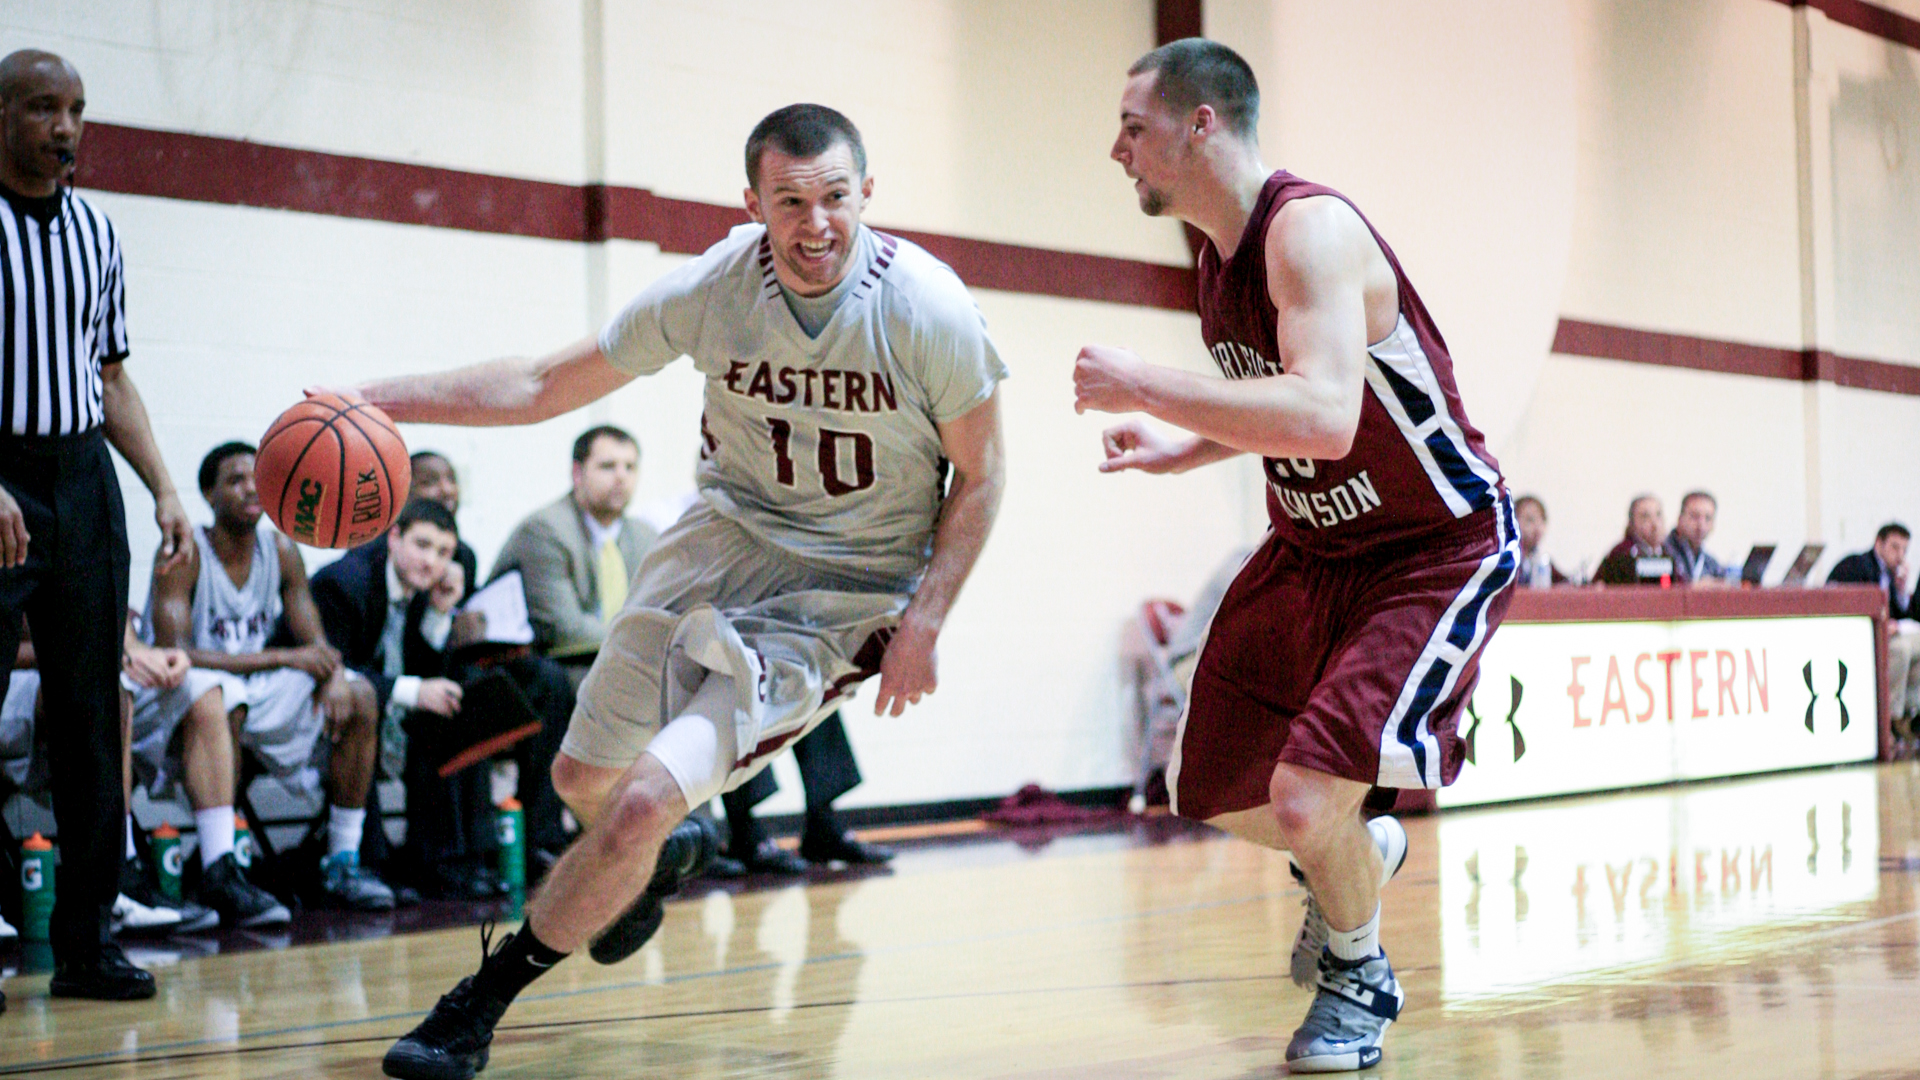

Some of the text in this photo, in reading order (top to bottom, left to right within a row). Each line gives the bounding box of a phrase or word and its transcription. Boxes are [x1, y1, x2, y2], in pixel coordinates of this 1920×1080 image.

[723, 360, 898, 412] EASTERN
[765, 416, 875, 497] 10
[352, 467, 382, 525] ROCK
[1566, 648, 1769, 728] EASTERN
[21, 858, 42, 891] G
